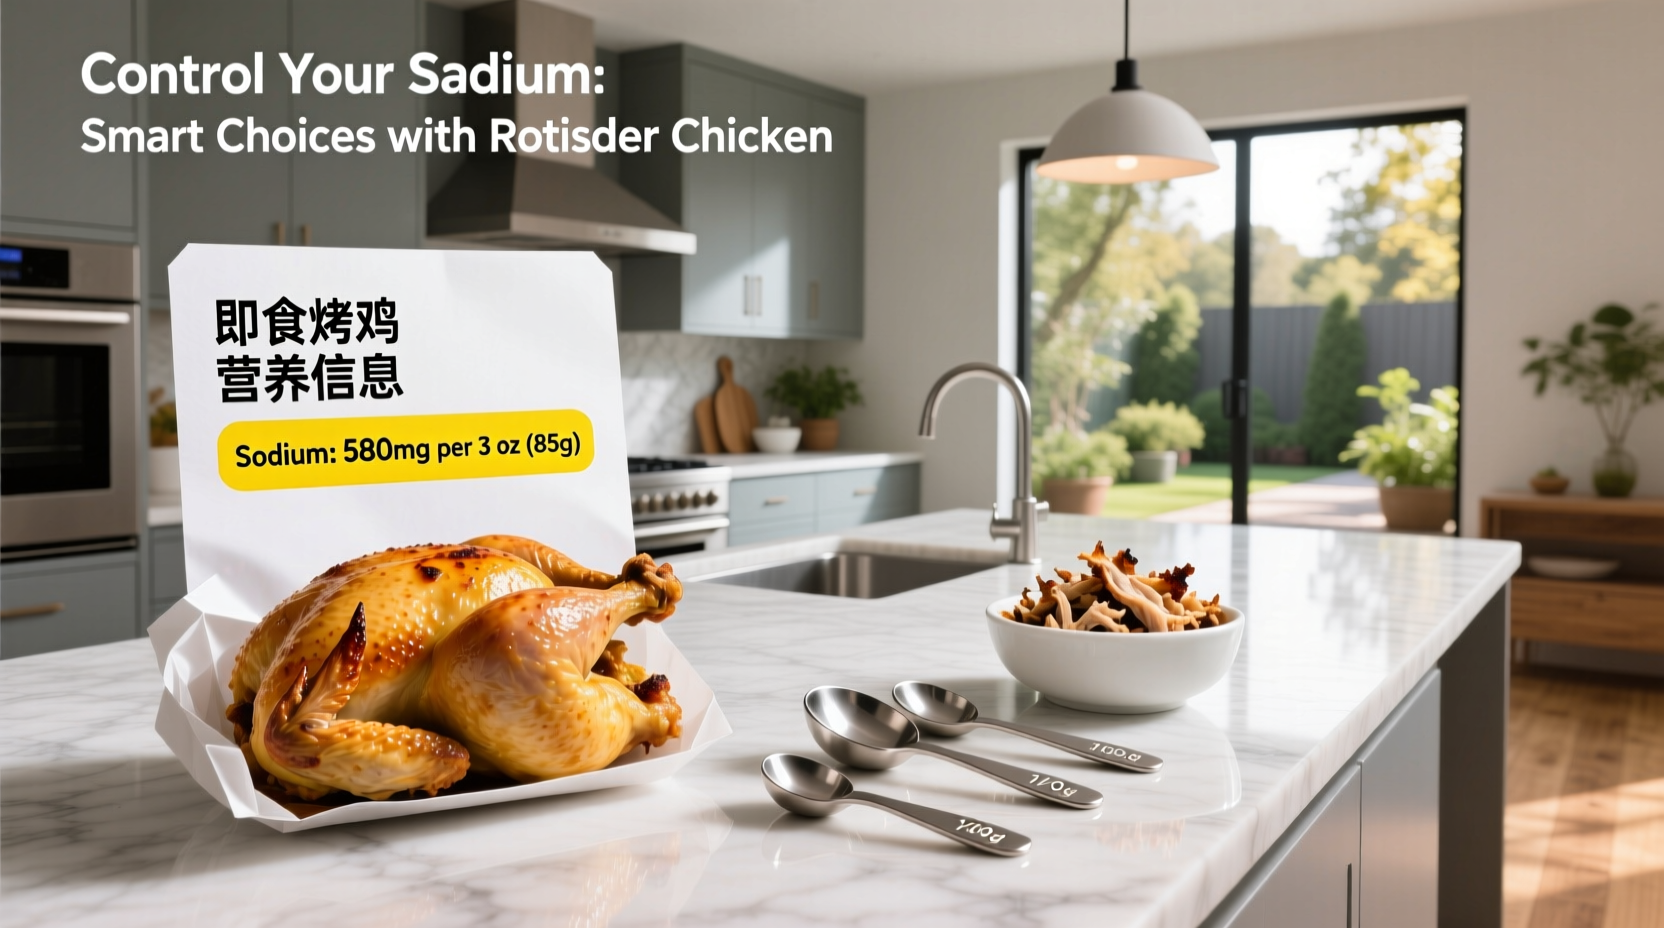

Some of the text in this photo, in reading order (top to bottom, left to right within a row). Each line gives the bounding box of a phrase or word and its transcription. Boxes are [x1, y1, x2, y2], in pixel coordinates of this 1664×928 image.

[215, 295, 399, 347] 即食烤鸡
[216, 352, 404, 404] 营养信息
[235, 431, 581, 468] Sodium: 580mg per 3 oz (85g)
